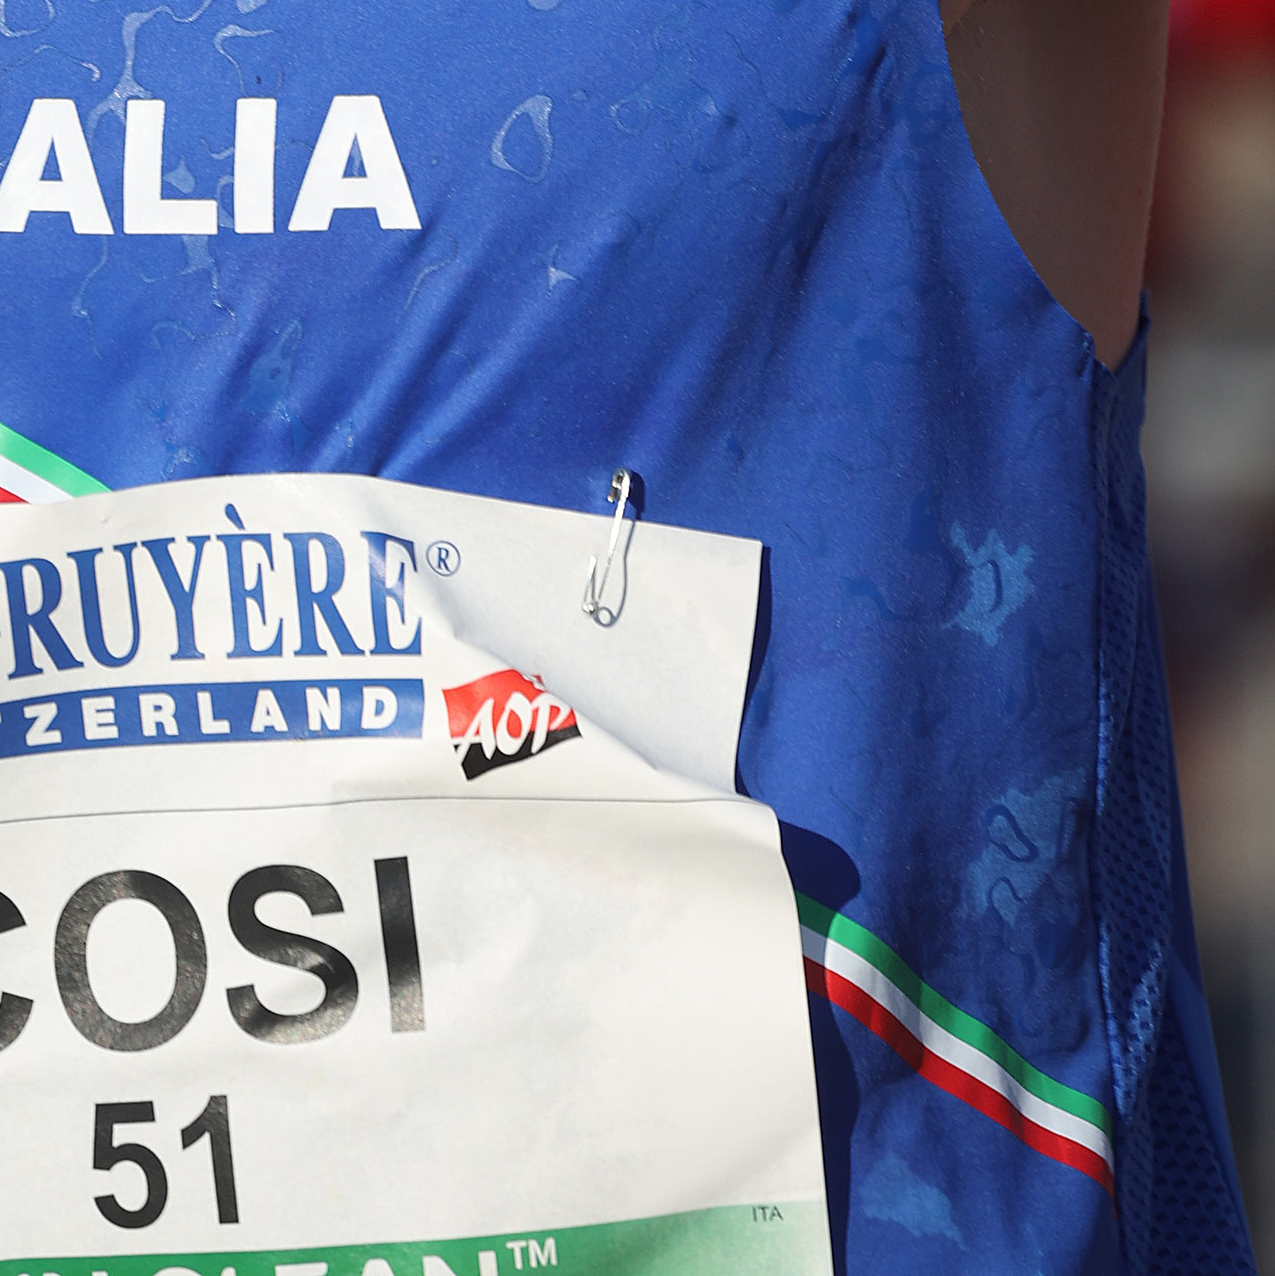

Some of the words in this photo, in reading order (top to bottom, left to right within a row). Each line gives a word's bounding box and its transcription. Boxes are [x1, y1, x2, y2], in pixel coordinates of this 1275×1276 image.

[453, 690, 572, 765] AOP
[92, 1095, 240, 1229] 51
[752, 1205, 784, 1223] ITA
